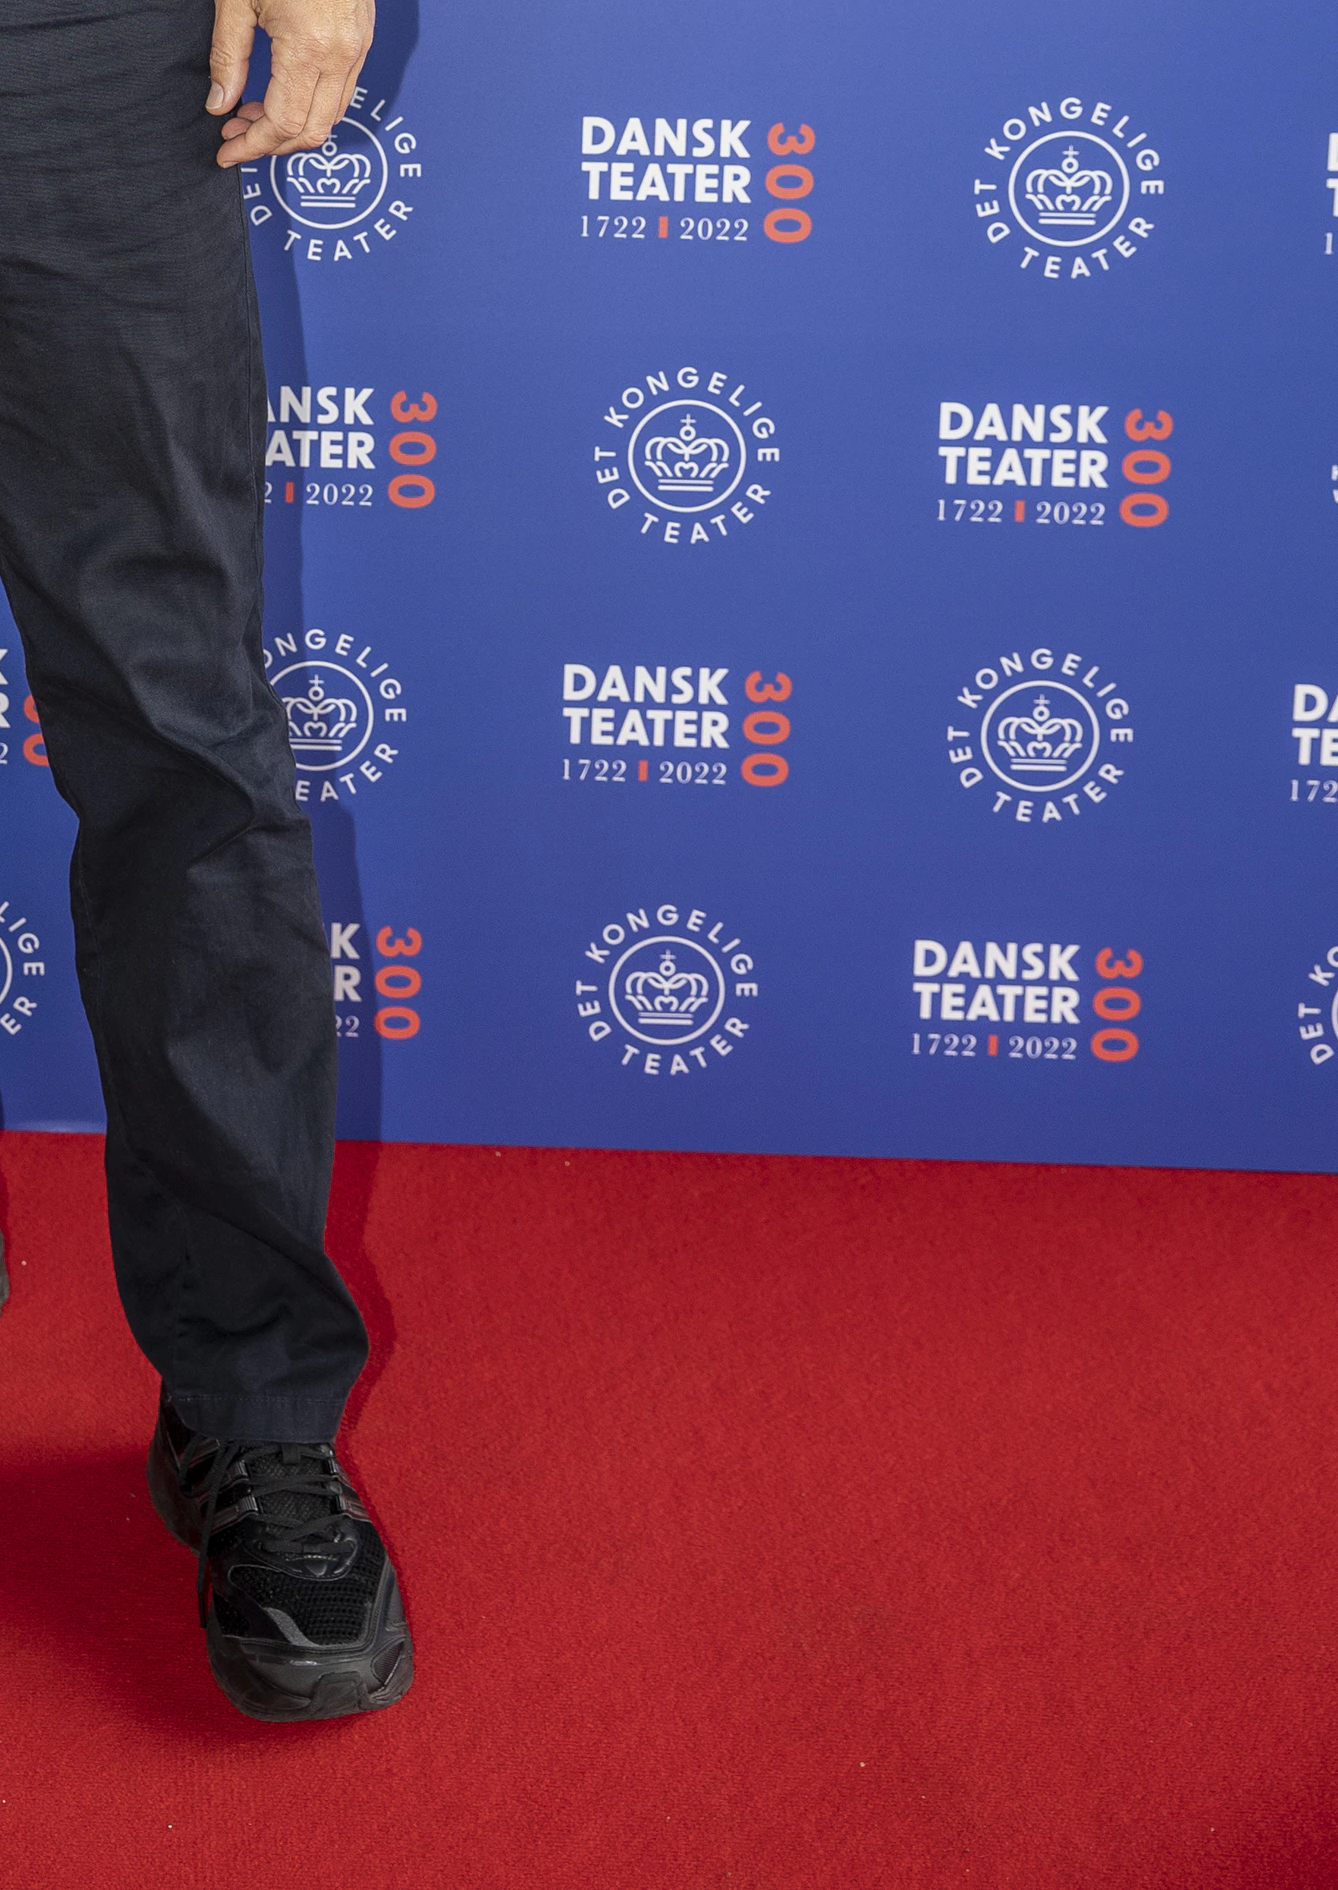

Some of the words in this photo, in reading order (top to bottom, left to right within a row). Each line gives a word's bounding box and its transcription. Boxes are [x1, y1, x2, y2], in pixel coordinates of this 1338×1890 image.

[984, 96, 1165, 195] KONGELIGE
[283, 199, 414, 262] TEATER
[973, 178, 1011, 244] DET
[1019, 216, 1155, 280] TEATER
[388, 391, 437, 508] 300
[938, 401, 1110, 445] DANSK
[305, 482, 374, 507] 2022
[937, 445, 1109, 489] TEATER
[1120, 409, 1172, 527] 300
[937, 498, 1004, 523] 1722
[1035, 501, 1106, 526] 2022
[562, 663, 730, 706] DANSK
[562, 706, 730, 749] TEATER
[742, 671, 792, 787] 300
[562, 758, 627, 782] 1722
[659, 760, 727, 785] 2022
[584, 904, 759, 997] KONGELIGE
[913, 939, 1081, 982] DANSK
[373, 927, 422, 1039] 300
[575, 979, 612, 1042] DET
[912, 981, 1081, 1025] TEATER
[1092, 949, 1143, 1061] 300
[621, 1017, 750, 1076] TEATER
[912, 1032, 977, 1057] 1722
[1008, 1035, 1078, 1060] 2022
